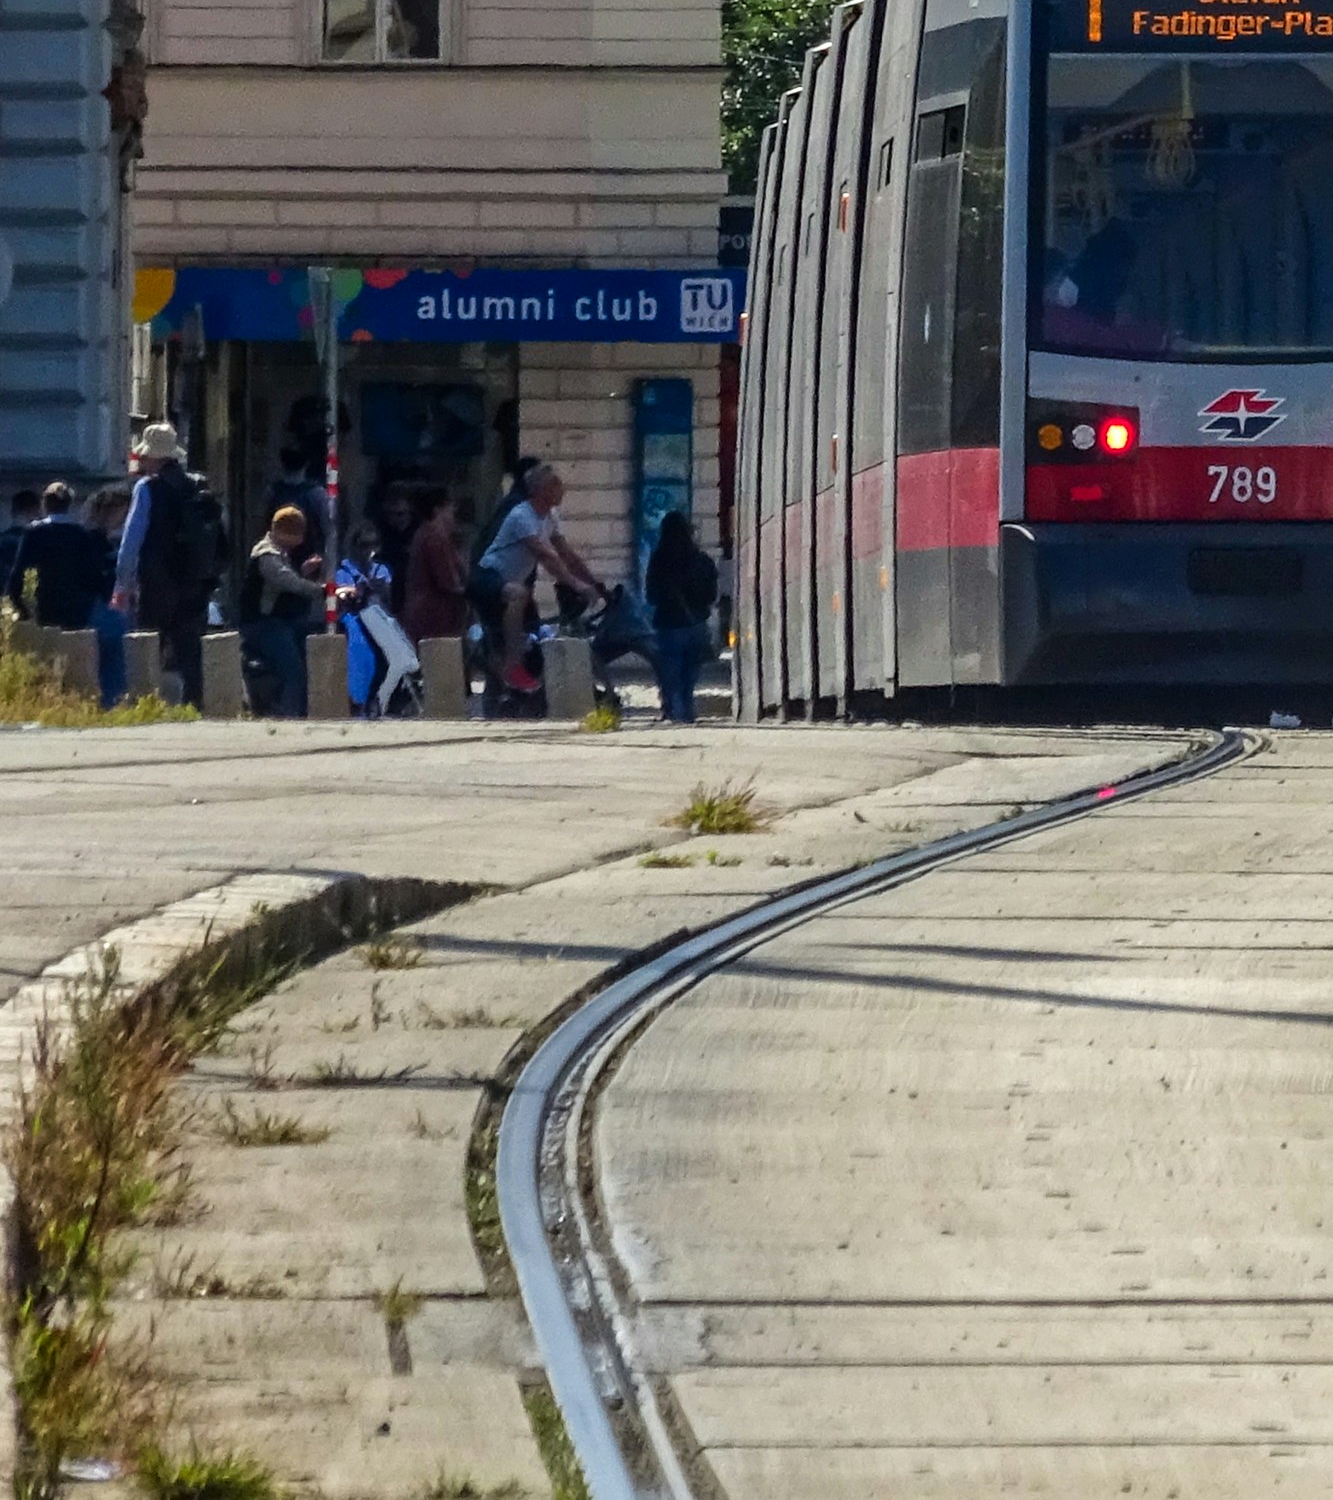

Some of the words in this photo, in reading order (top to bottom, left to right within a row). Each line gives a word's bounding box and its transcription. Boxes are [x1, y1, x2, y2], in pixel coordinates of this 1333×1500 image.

[417, 289, 554, 320] alumni
[575, 290, 657, 320] club
[684, 284, 729, 311] TU
[1207, 465, 1276, 503] 789
